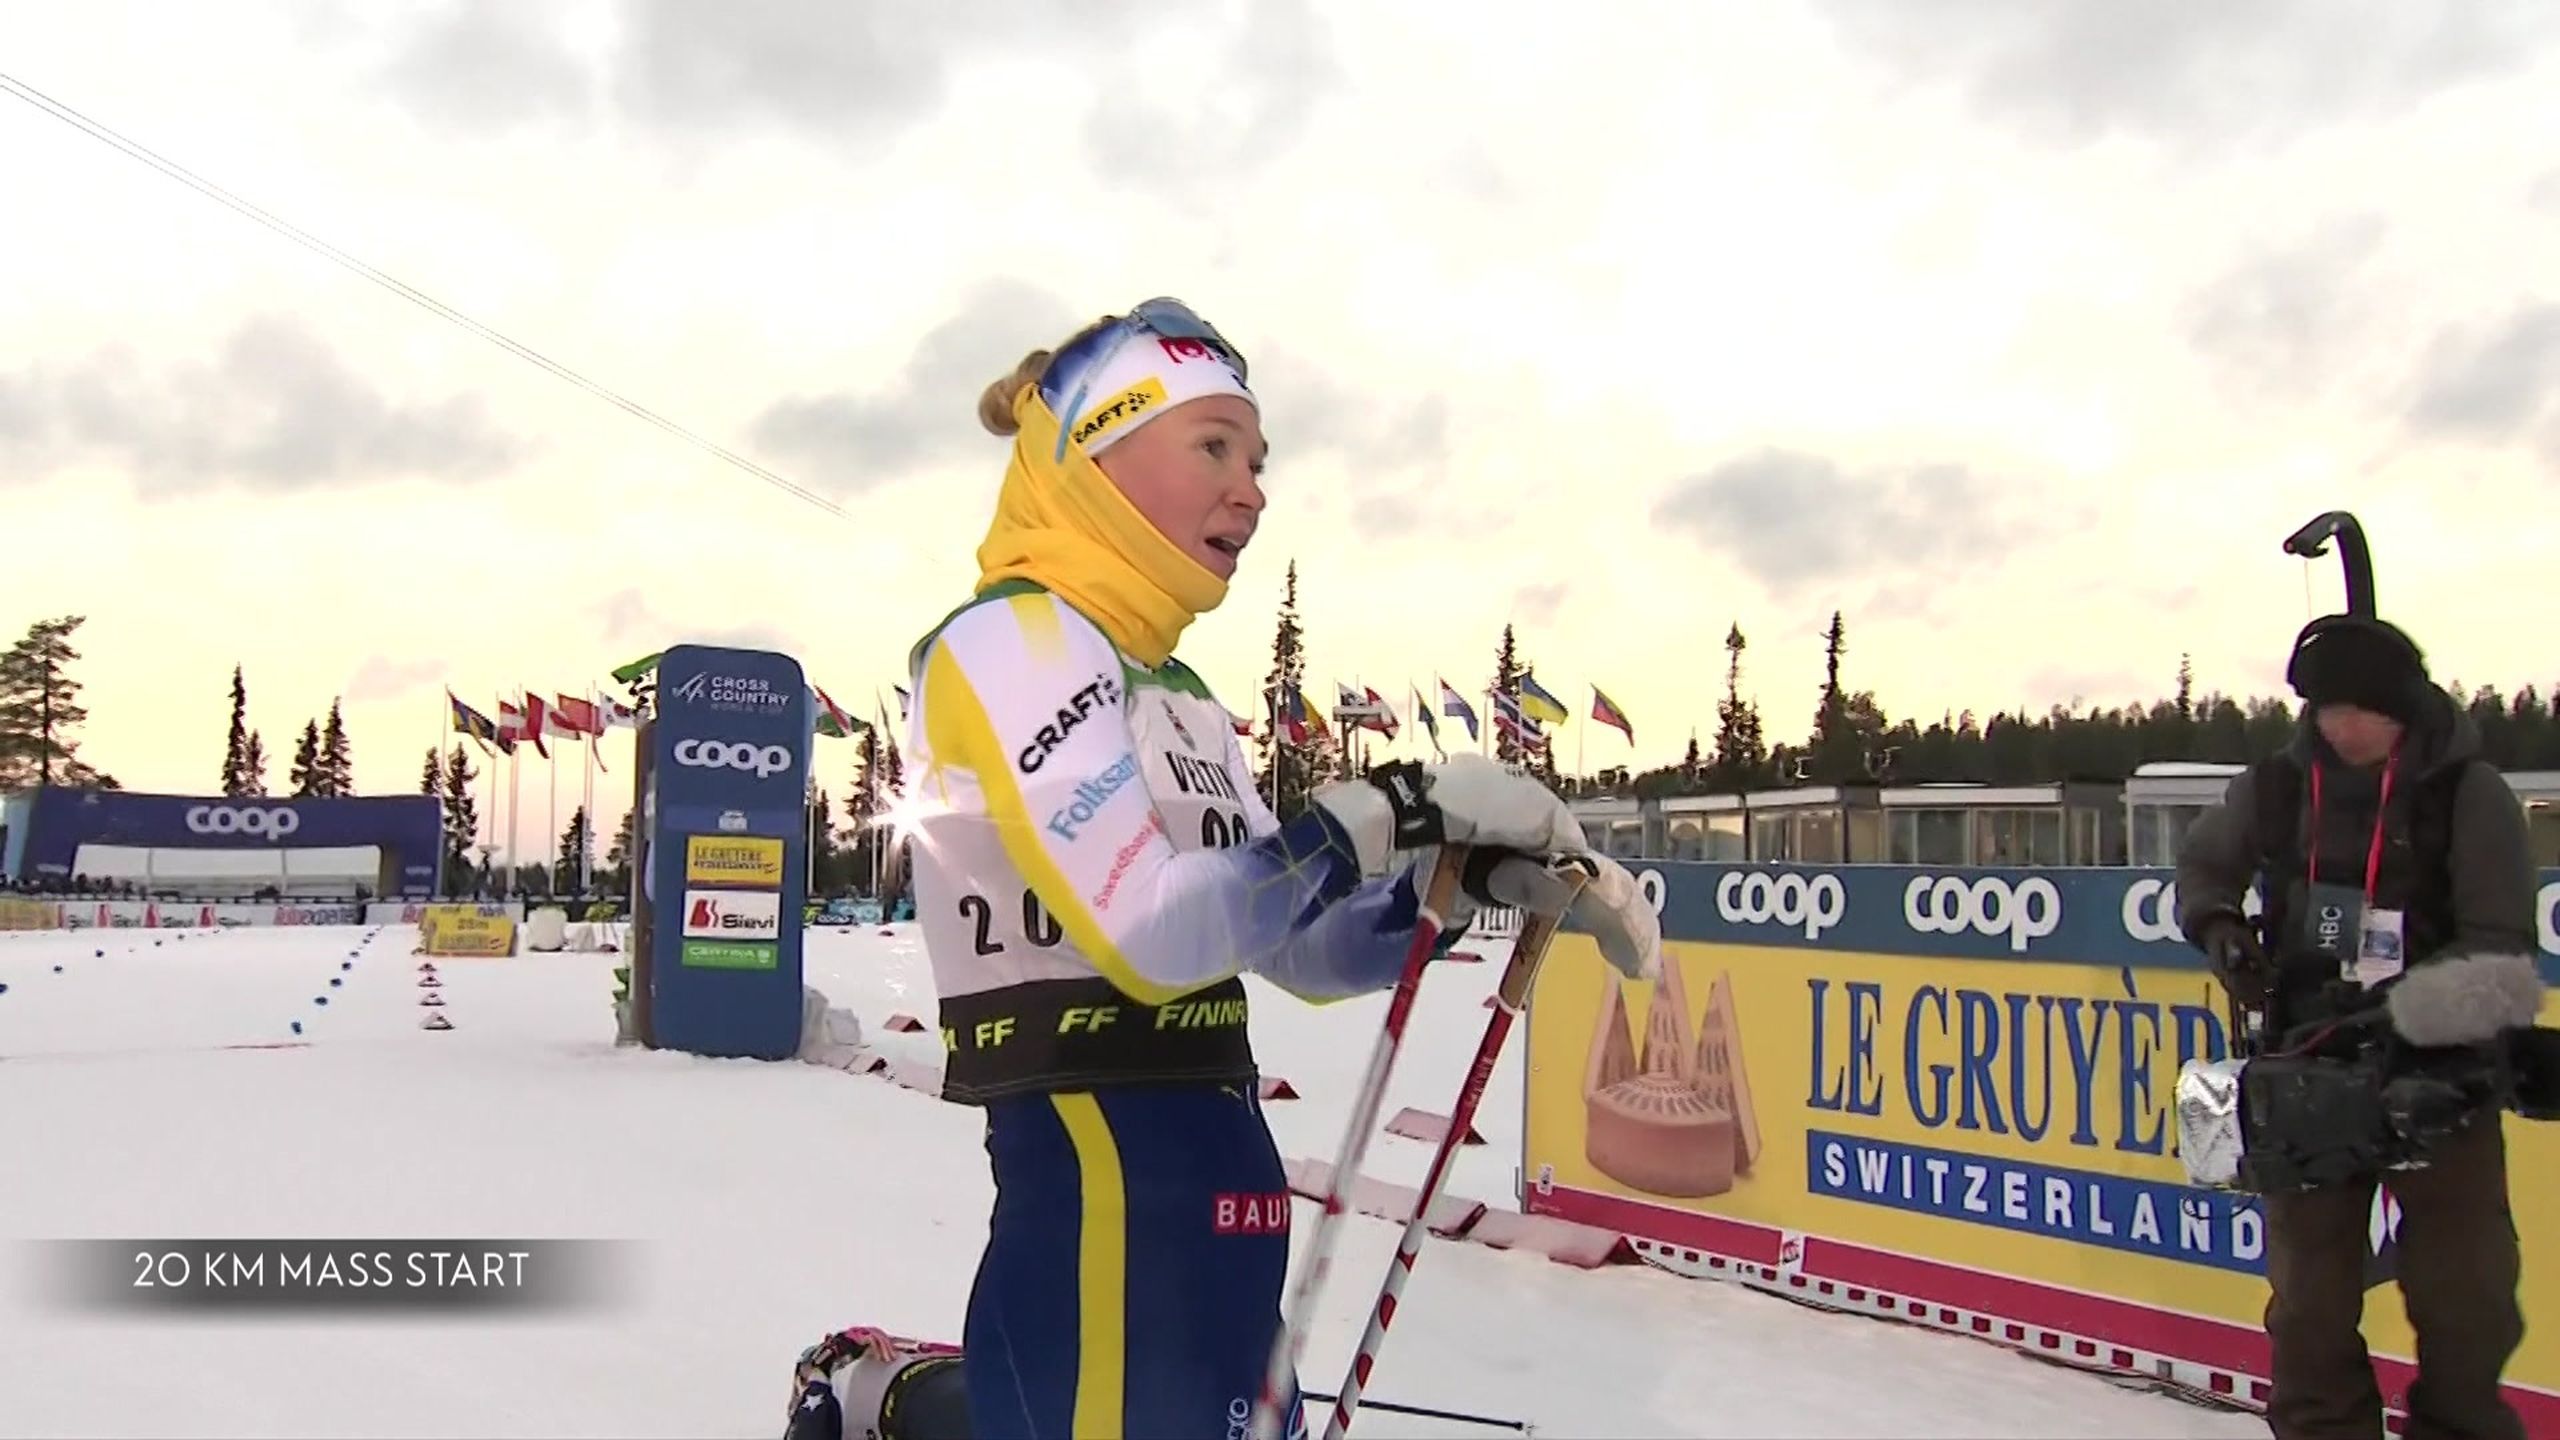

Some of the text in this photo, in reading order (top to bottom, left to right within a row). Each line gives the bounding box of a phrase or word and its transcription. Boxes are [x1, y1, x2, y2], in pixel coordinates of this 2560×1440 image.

[710, 689, 790, 706] COUNTRY
[711, 676, 769, 692] CROSS
[1018, 682, 1104, 775] CRAFT
[673, 738, 792, 779] coop
[186, 805, 299, 841] coop
[722, 913, 774, 929] Sievi
[1716, 870, 1846, 940] coop
[1904, 875, 2061, 952] coop
[975, 1017, 1017, 1049] FF
[1056, 1005, 1120, 1034] FF
[1805, 978, 1884, 1116] LE
[1822, 1141, 2264, 1261] SWITZERLAND
